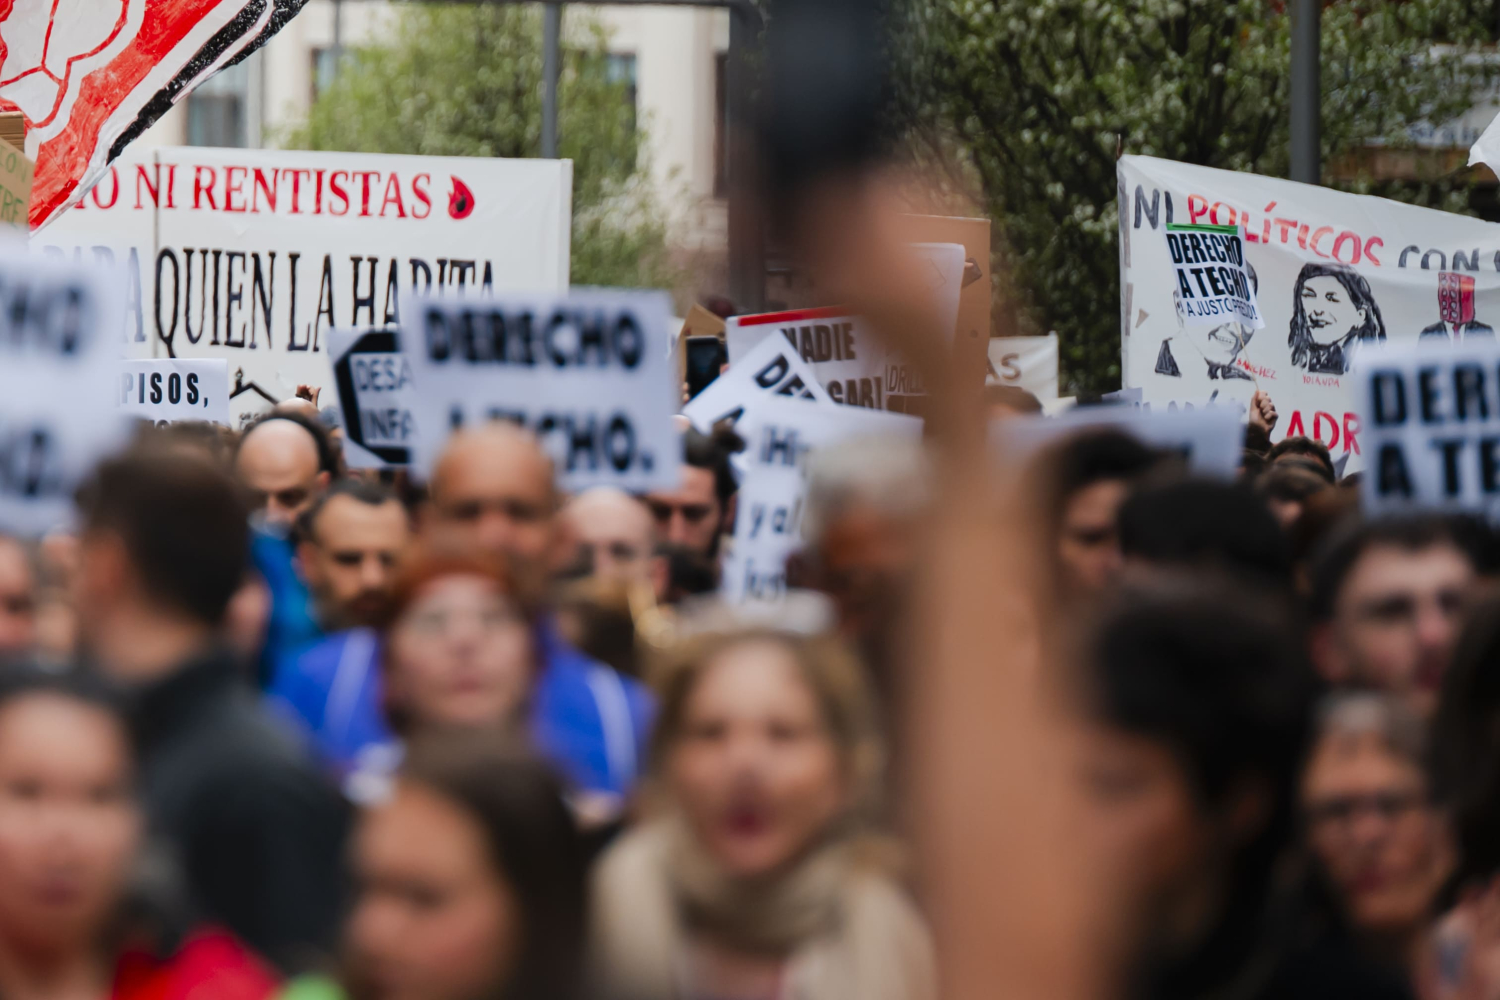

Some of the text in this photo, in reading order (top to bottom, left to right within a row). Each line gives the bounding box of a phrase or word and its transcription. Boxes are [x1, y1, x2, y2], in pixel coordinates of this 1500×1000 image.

[134, 163, 176, 210] NI
[191, 163, 431, 219] RENTISTAS
[1134, 184, 1174, 229] NI
[1166, 233, 1243, 267] DERECHO
[155, 247, 276, 358] QUIEN
[287, 252, 335, 352] LA
[1177, 266, 1251, 301] A TECHO
